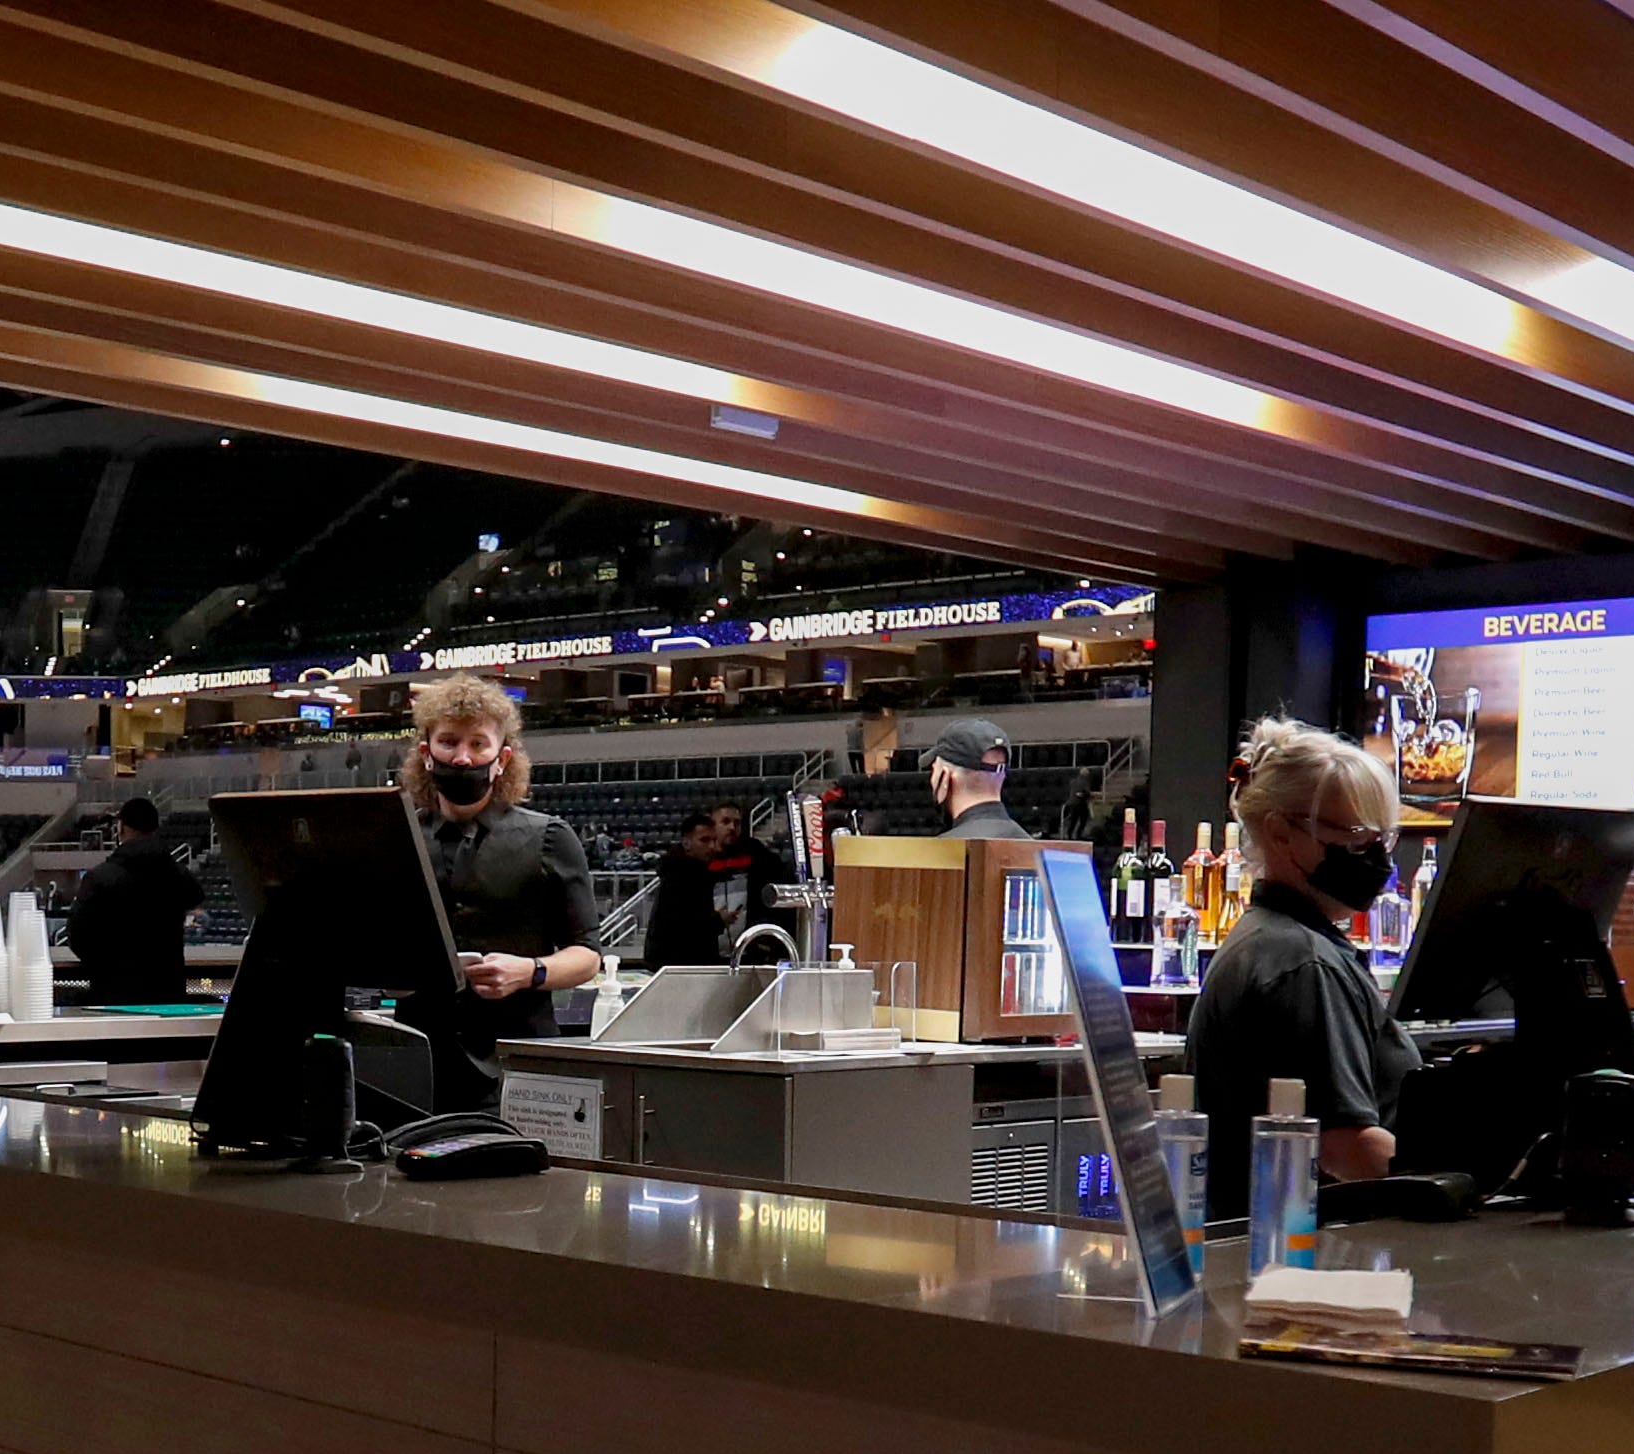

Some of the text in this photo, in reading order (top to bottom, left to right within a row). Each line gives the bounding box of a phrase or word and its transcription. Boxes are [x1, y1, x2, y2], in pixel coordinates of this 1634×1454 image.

[769, 601, 1001, 641] GAINBRIDGE FIELDHOUSE
[1483, 609, 1607, 638] BEVERAGE
[435, 635, 612, 670] GAINBRIDGE FIELDHOUSE
[198, 668, 271, 689] FIELDHOUSE
[1532, 750, 1569, 760] Regular
[1531, 769, 1573, 779] Red Bull
[1530, 790, 1598, 800] Regular Soda
[1079, 1155, 1090, 1198] TRULY
[1100, 1154, 1110, 1197] TRULY
